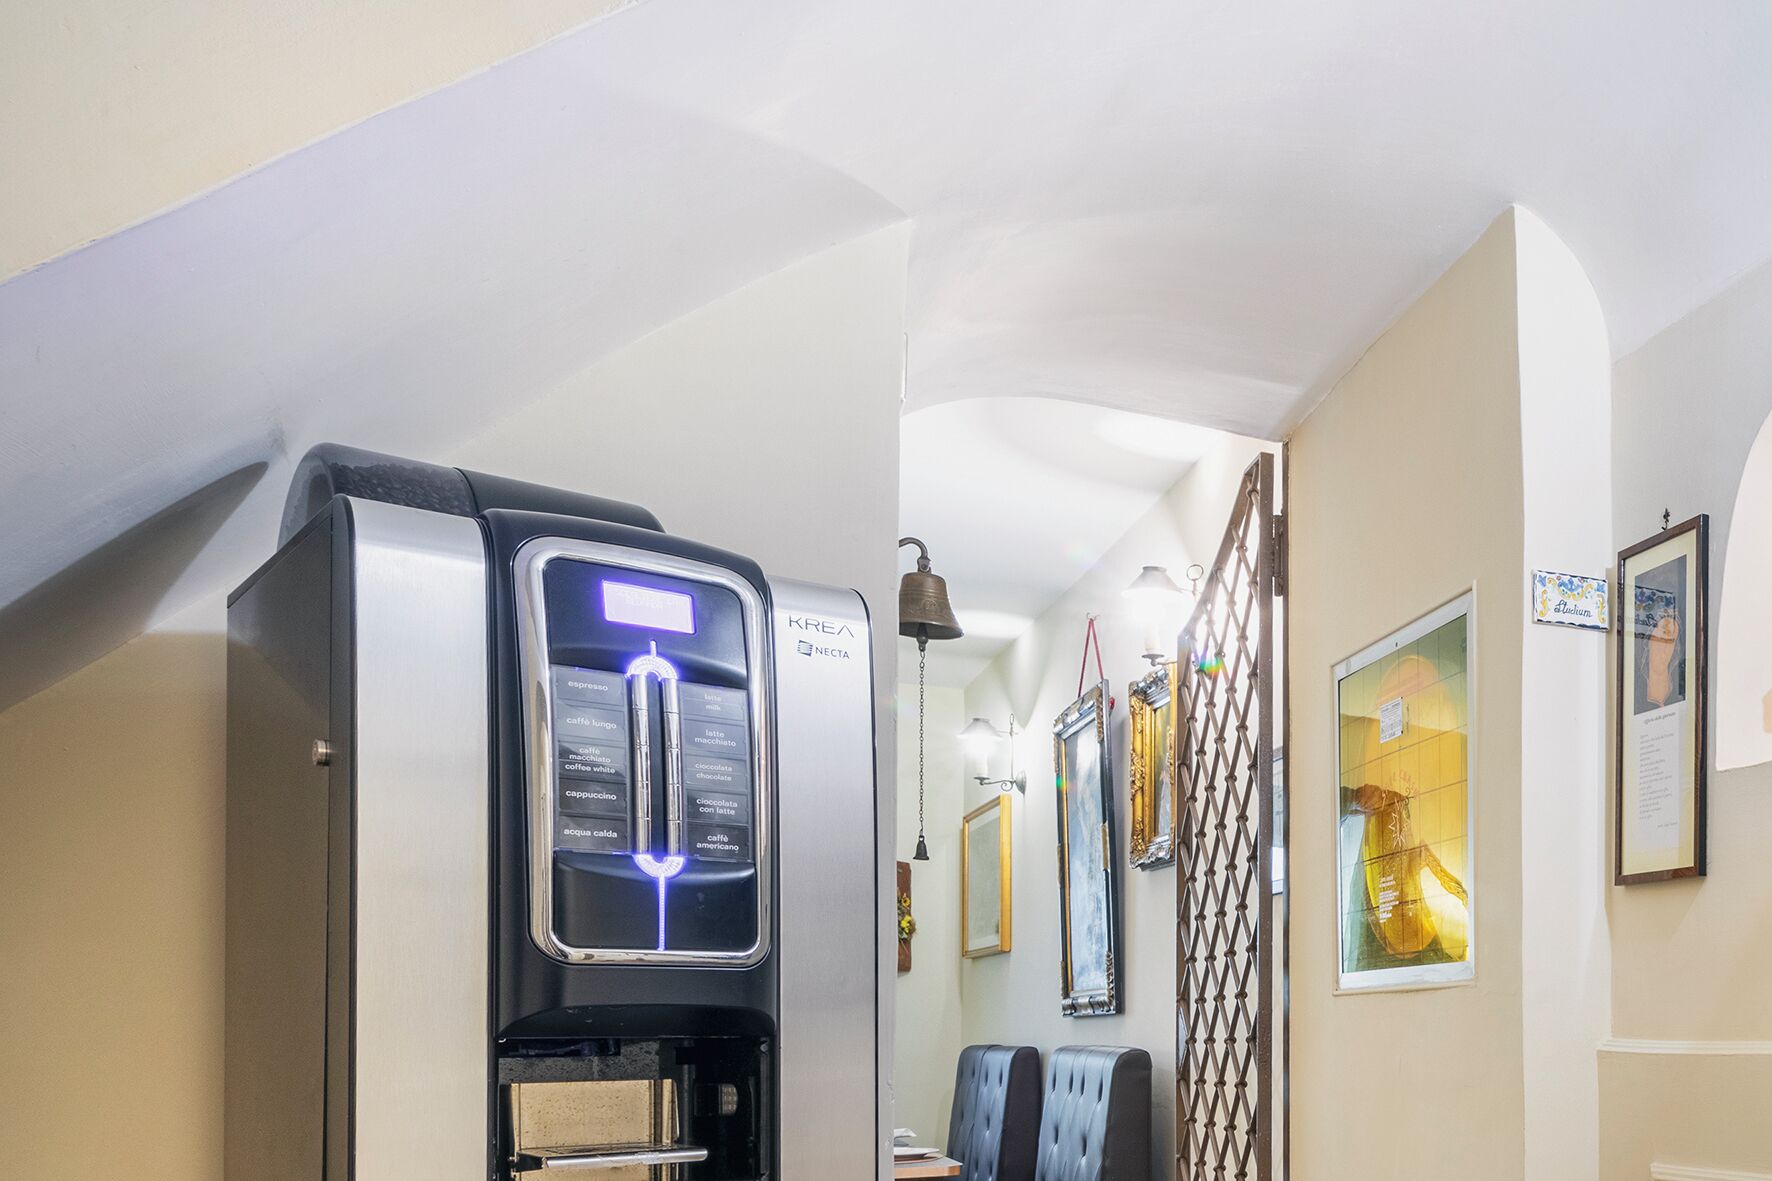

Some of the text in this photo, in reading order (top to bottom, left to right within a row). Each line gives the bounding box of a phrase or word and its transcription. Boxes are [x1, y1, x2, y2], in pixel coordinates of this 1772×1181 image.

[1554, 600, 1592, 618] Studium
[789, 616, 854, 638] KREA
[816, 647, 850, 659] NECTA
[568, 681, 608, 691] espresso
[705, 693, 721, 701] latte
[566, 717, 617, 730] caffè lungo
[705, 729, 725, 737] latte
[695, 737, 737, 747] macchiato
[580, 747, 600, 755] caffè
[569, 754, 611, 763] macchiato
[565, 763, 615, 774] coffee white
[695, 763, 733, 772] cioccolata
[696, 773, 732, 781] chocolate
[566, 790, 617, 800] cappuccino
[696, 798, 738, 808] cioccolata
[717, 807, 735, 815] latte
[564, 828, 618, 838] acqua calda
[707, 834, 728, 843] caffè
[696, 842, 739, 851] americano
